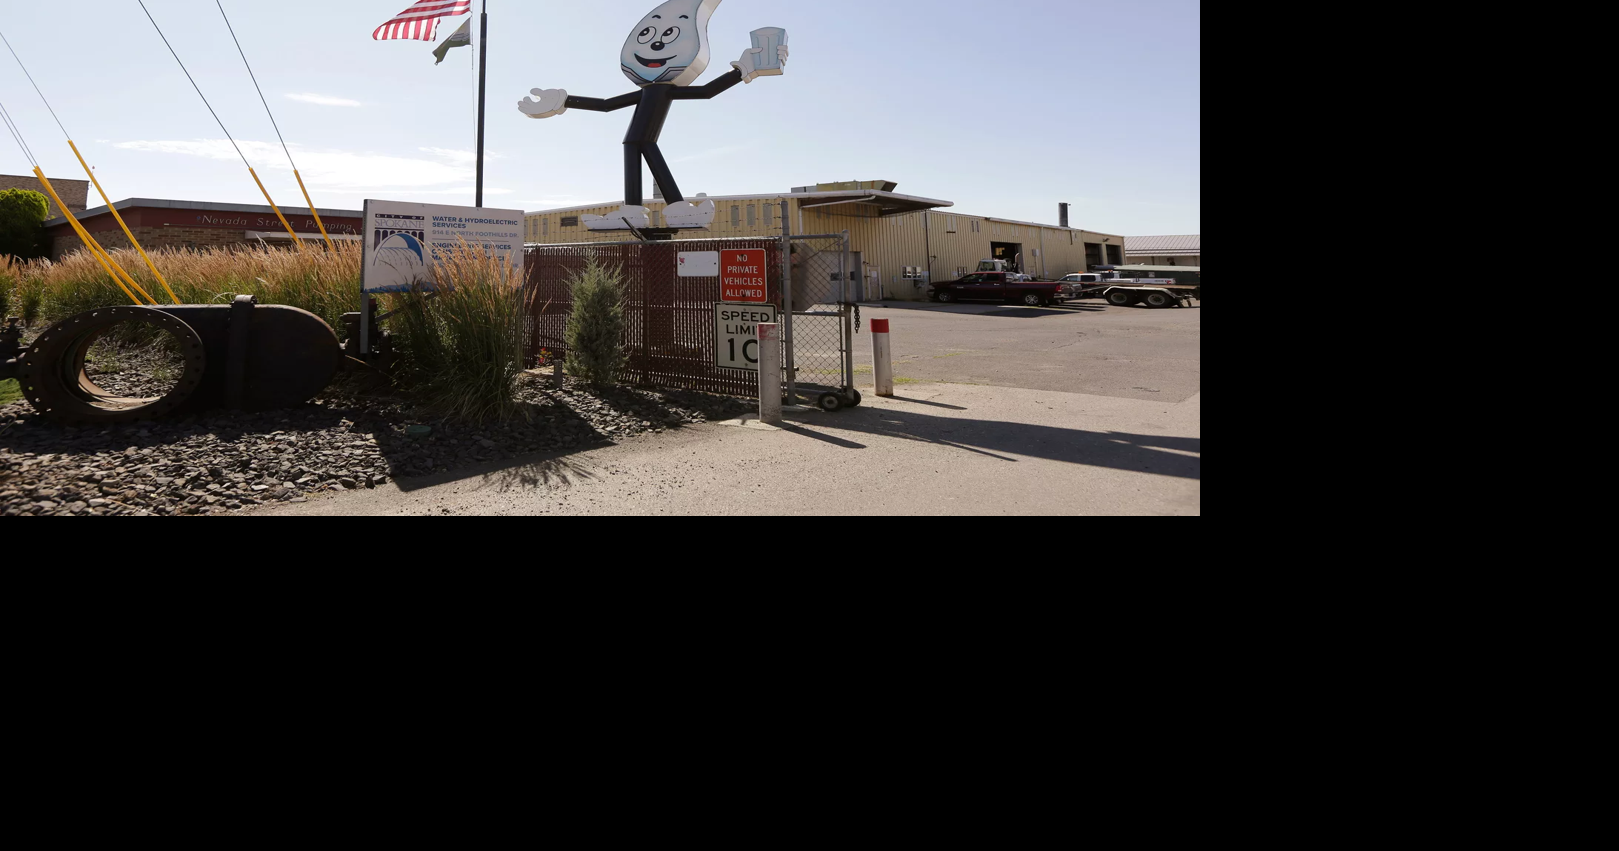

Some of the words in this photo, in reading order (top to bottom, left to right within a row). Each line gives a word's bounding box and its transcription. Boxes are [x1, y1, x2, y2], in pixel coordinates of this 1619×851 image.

[202, 215, 247, 226] Nevada
[256, 217, 294, 228] Stret
[374, 219, 425, 229] SPOKANE
[465, 218, 518, 226] HYDROELECTRIC
[736, 254, 748, 262] NO
[727, 266, 758, 274] PRIVATE
[724, 277, 763, 286] VEHICLES
[725, 289, 762, 298] ALLOWED
[721, 310, 770, 322] SPEED
[726, 324, 758, 335] LIMI
